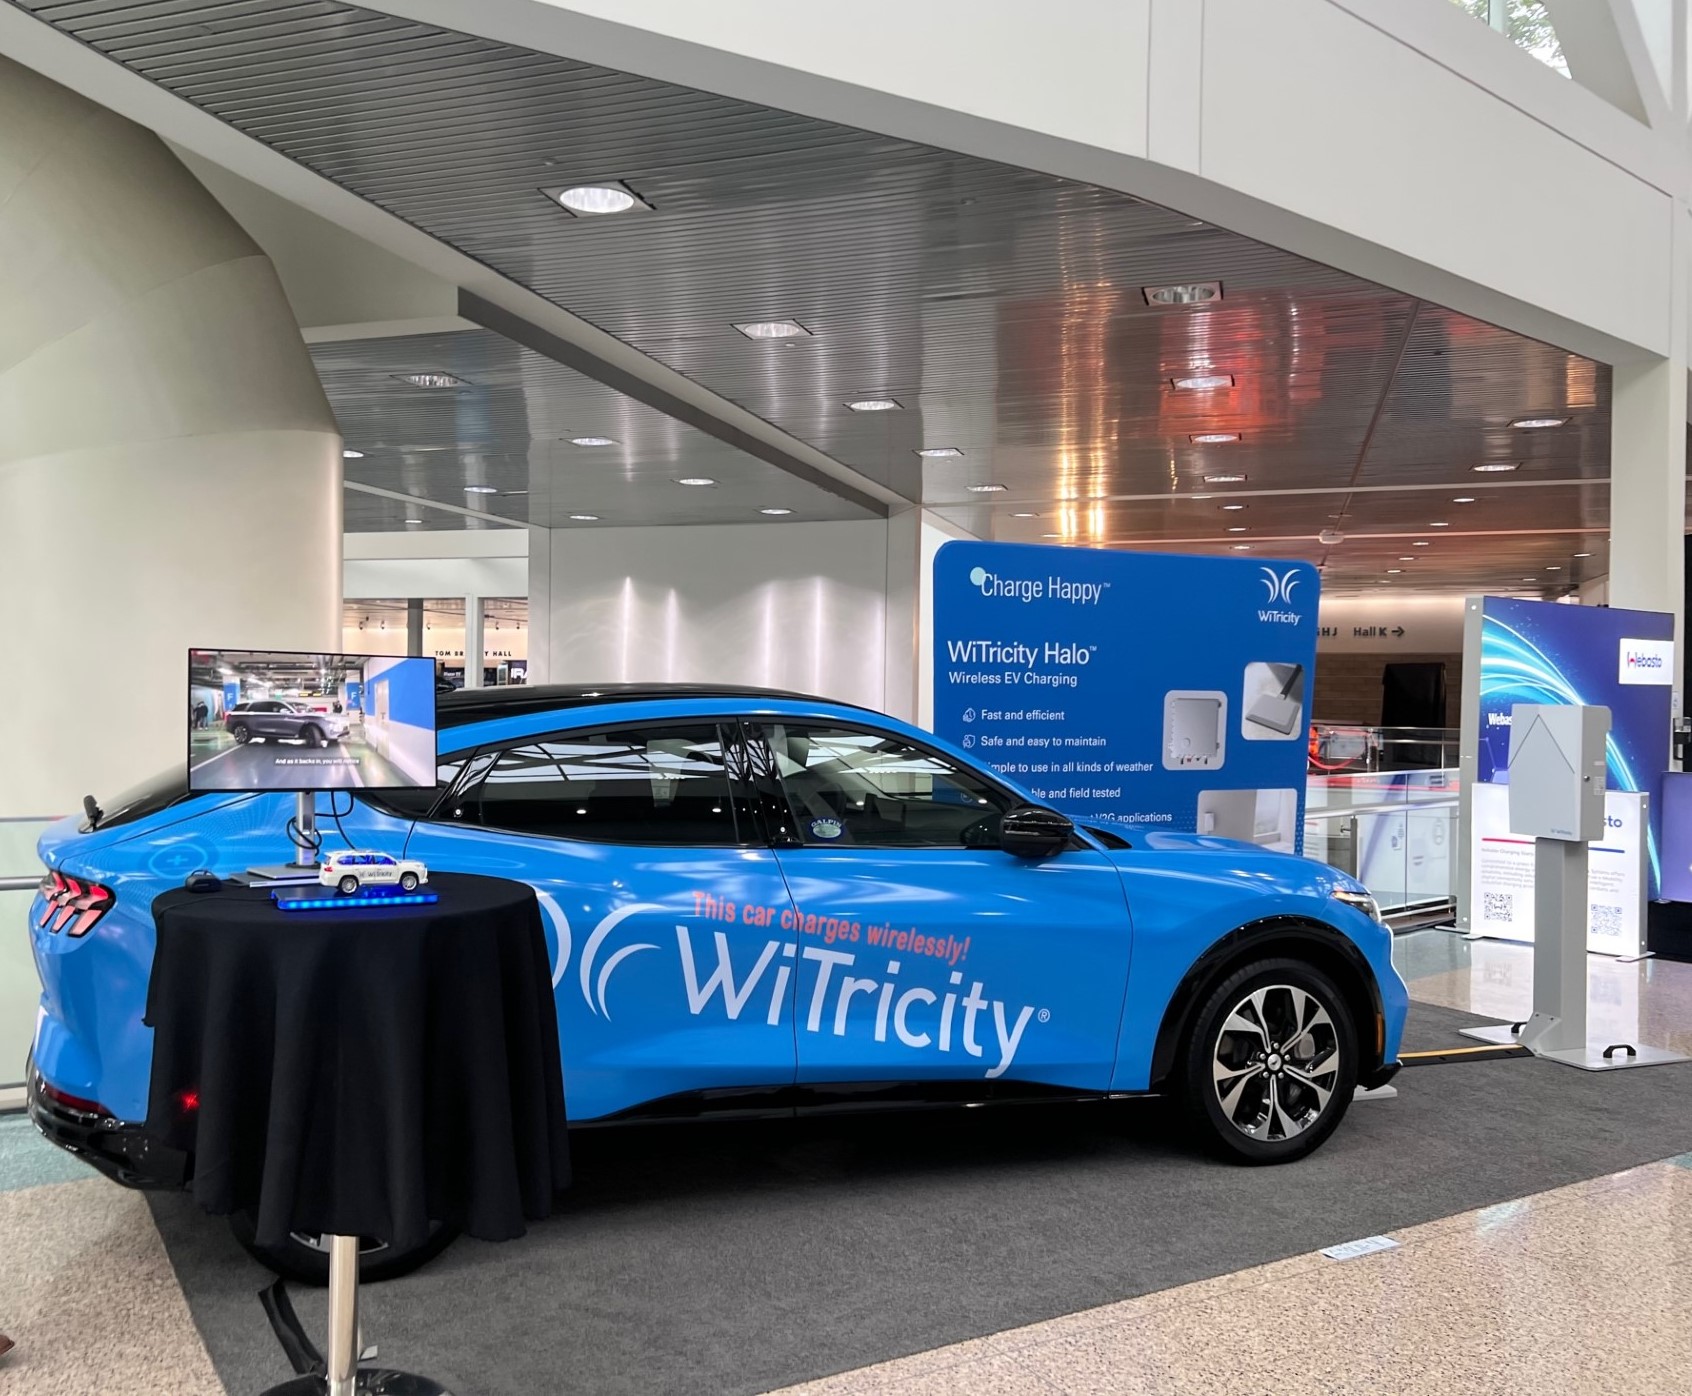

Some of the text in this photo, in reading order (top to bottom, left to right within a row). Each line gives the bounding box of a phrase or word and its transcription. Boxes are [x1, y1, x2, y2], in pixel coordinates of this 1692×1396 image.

[981, 572, 1043, 603] Charge
[1257, 609, 1302, 627] WiTricity
[1353, 626, 1376, 637] Hall
[1378, 626, 1388, 637] K
[947, 640, 1039, 669] WiTricity
[949, 671, 1078, 688] Wireless EV Charging
[981, 709, 1065, 721] Fast and efficient
[1487, 712, 1513, 726] Webas
[980, 735, 1107, 749] Safe and easy to maintain
[984, 761, 1154, 775] imple to use in all kinds of weather
[1048, 787, 1067, 799] and
[1069, 787, 1090, 798] field
[1092, 787, 1121, 798] tested
[810, 818, 843, 829] GALPIN
[1117, 811, 1173, 823] applications
[692, 890, 971, 967] This car charges wirelessly!
